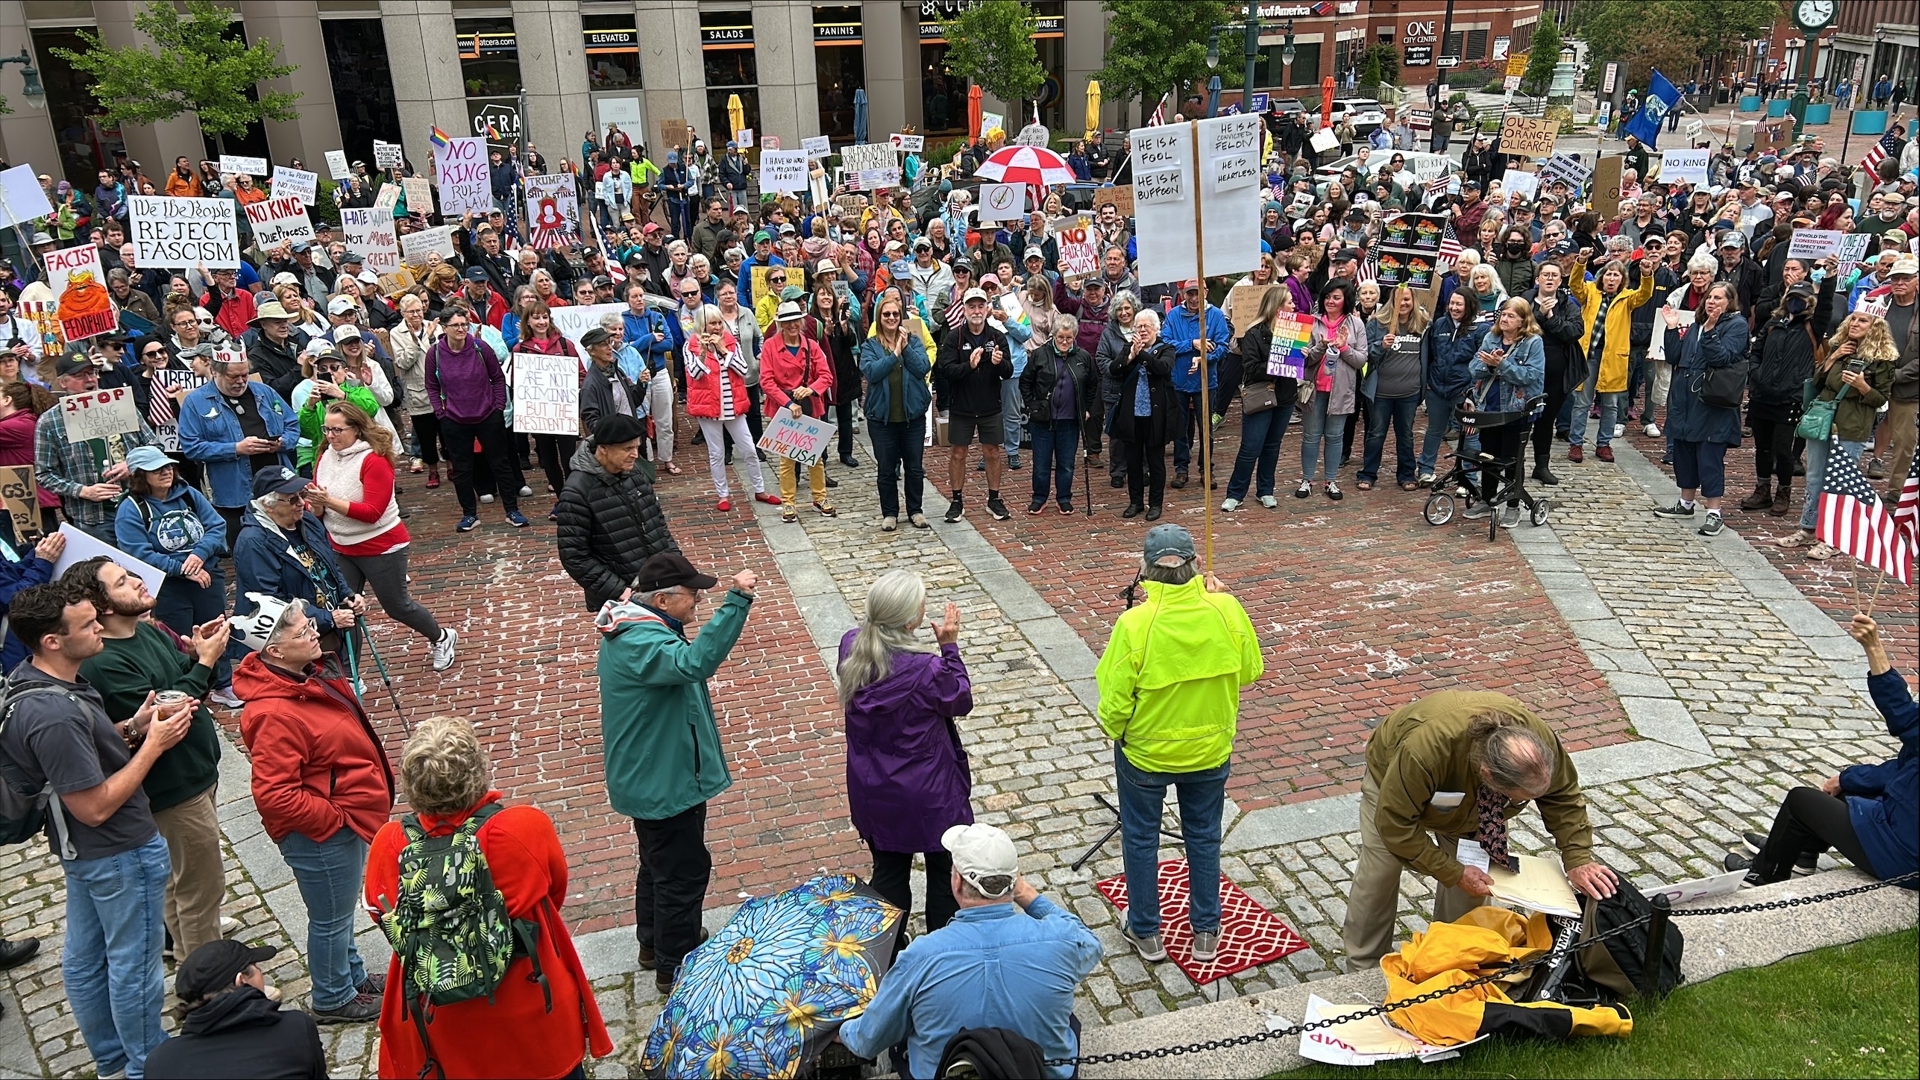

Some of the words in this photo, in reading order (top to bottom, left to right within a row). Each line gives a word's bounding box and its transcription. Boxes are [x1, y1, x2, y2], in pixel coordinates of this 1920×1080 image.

[1275, 5, 1310, 16] America
[709, 29, 744, 39] SALADS
[820, 26, 855, 35] PANINIS
[1407, 21, 1436, 36] ONE
[592, 33, 630, 43] ELEVATED
[1417, 35, 1438, 43] CENTER
[1221, 123, 1232, 133] HE
[1236, 123, 1245, 131] IS
[1247, 121, 1256, 129] A
[1506, 117, 1552, 131] OUST
[1217, 131, 1252, 141] CONVICTED
[1504, 129, 1553, 141] ORANGE
[446, 140, 477, 161] NO
[848, 144, 889, 154] DEMOCRACY
[1138, 138, 1152, 151] HE
[1156, 137, 1167, 148] IS
[1168, 136, 1177, 146] A
[1215, 137, 1254, 151] FELON
[1500, 140, 1554, 153] OLIGARCH
[1141, 152, 1172, 164] FOOL
[1222, 160, 1232, 170] HE
[1235, 158, 1247, 167] IS
[1665, 158, 1680, 167] NO
[1683, 158, 1706, 167] KING
[441, 163, 488, 185] KING
[528, 174, 570, 186] TRUMP'S
[1138, 175, 1152, 187] HE
[1156, 174, 1168, 184] IS
[1170, 173, 1179, 182] A
[1218, 168, 1256, 183] HEARTLESS
[277, 181, 287, 189] NO
[451, 182, 482, 199] RULE
[1138, 185, 1179, 200] BUFFOON
[552, 190, 576, 199] STINKS
[134, 199, 159, 217] We
[187, 199, 233, 220] People
[443, 199, 460, 212] OF
[464, 193, 490, 210] LAW
[246, 204, 268, 224] NO
[267, 197, 304, 220] KING
[344, 210, 368, 226] HATE
[368, 210, 394, 227] WILL
[137, 221, 232, 240] REJECT
[1061, 228, 1087, 245] NO
[345, 234, 363, 245] NOT
[46, 246, 96, 271] FACIST
[137, 241, 235, 261] FASCISM
[367, 252, 397, 267] GREAT
[1067, 254, 1100, 274] WAY!
[787, 270, 803, 279] Vote
[561, 313, 582, 330] NO
[1278, 310, 1297, 321] SUPER
[63, 309, 116, 341] PEDOPHILE
[1276, 319, 1303, 331] CALLOUS
[1273, 327, 1300, 339] FASCIST
[1394, 334, 1421, 343] galize
[1271, 336, 1295, 347] RACIST
[216, 352, 230, 361] NO
[1270, 345, 1292, 356] SEXIST
[515, 355, 578, 373] IMMIGRANTS
[1269, 354, 1285, 364] NAZI
[1267, 362, 1297, 378] POTUS
[522, 371, 545, 386] ARE
[549, 373, 572, 388] NOT
[66, 388, 125, 414] STOP
[516, 385, 577, 403] CRIMINALS
[84, 404, 119, 419] KING
[525, 401, 550, 416] BUT
[551, 403, 573, 418] THE
[78, 415, 125, 430] USEFUL
[82, 422, 129, 438] LOGJAM
[514, 415, 567, 432] PRESIDENT
[567, 419, 578, 433] IS
[805, 425, 819, 435] NO
[159, 425, 177, 436] FOR
[775, 426, 818, 451] KINGS
[758, 436, 773, 449] IN
[772, 440, 792, 455] THE
[788, 446, 817, 466] USA
[250, 614, 275, 640] NO
[1553, 914, 1583, 934] RESIS
